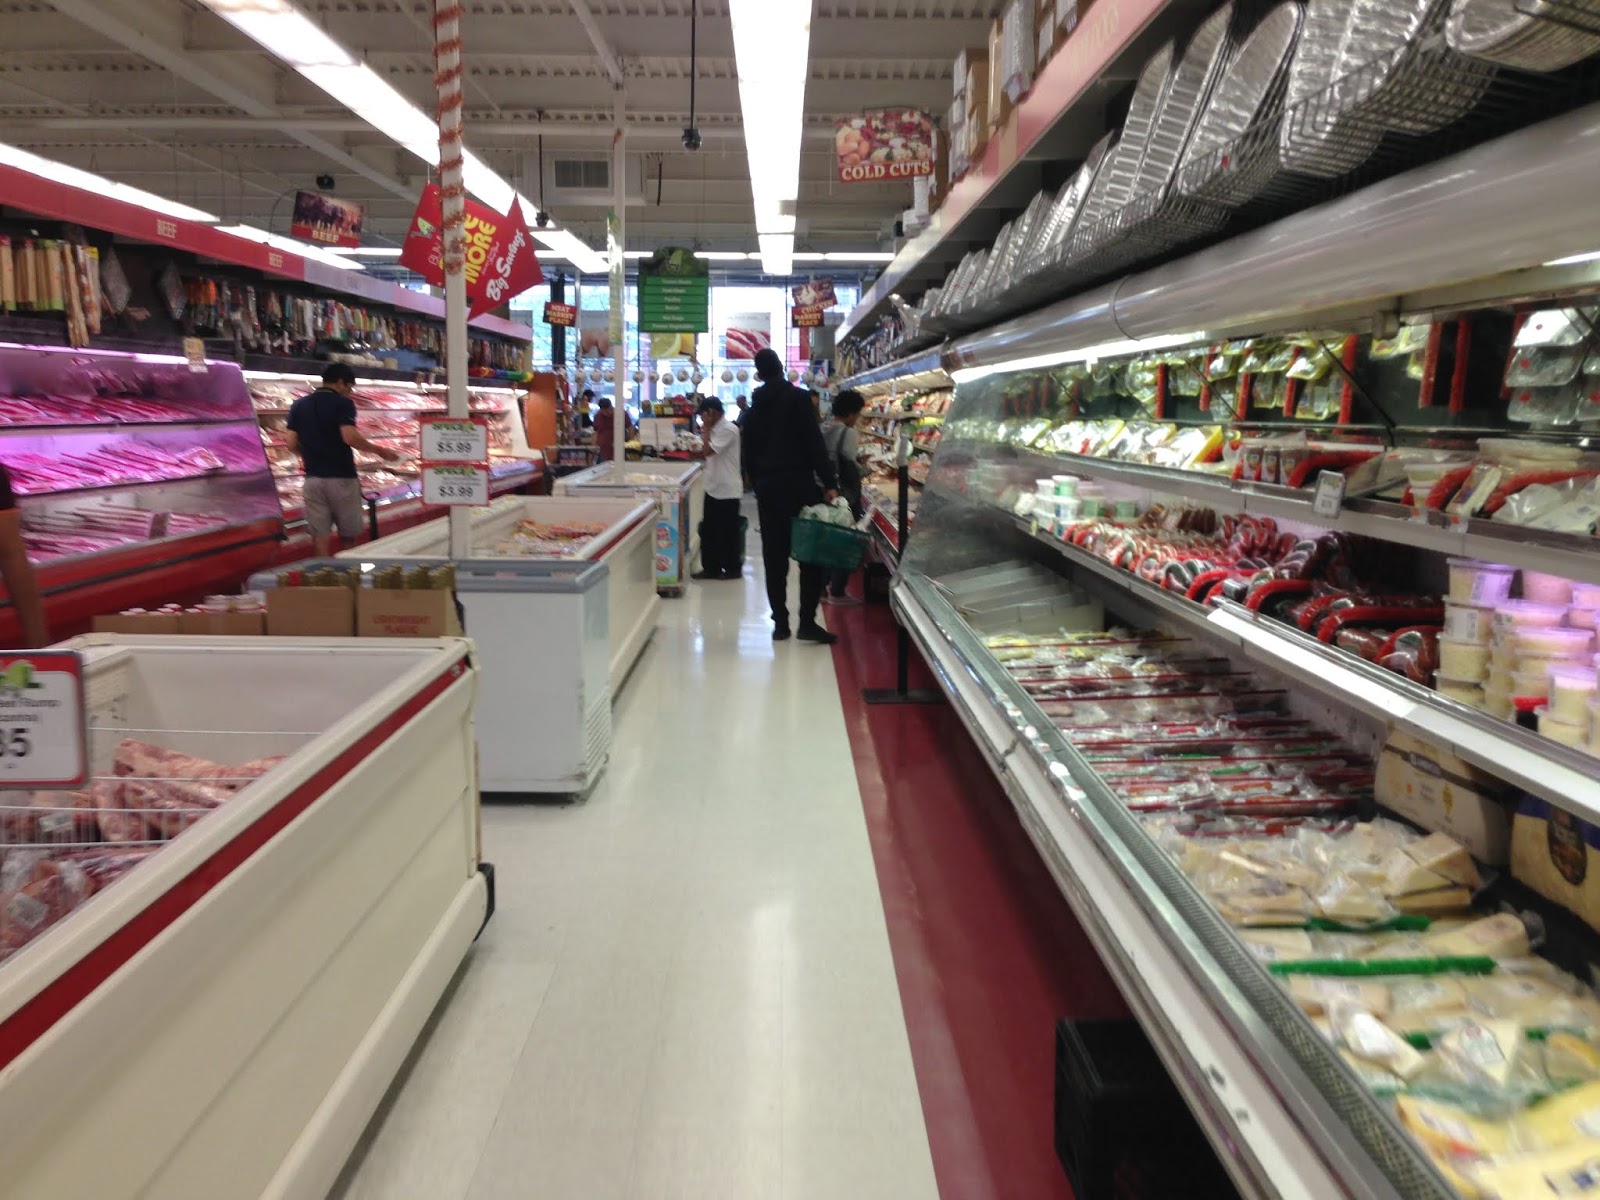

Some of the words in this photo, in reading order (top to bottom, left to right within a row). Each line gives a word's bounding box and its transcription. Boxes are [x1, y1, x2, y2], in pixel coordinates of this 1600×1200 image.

[841, 165, 885, 180] COLD
[889, 161, 931, 177] CUTS
[156, 219, 177, 239] BEEF
[312, 229, 339, 244] BEEF
[268, 252, 284, 268] BEEF
[464, 220, 497, 285] MORE
[496, 228, 526, 279] Savings
[485, 277, 510, 302] Big
[551, 303, 570, 313] MEAT
[436, 441, 472, 454] $5.99
[438, 485, 474, 498] $3.99
